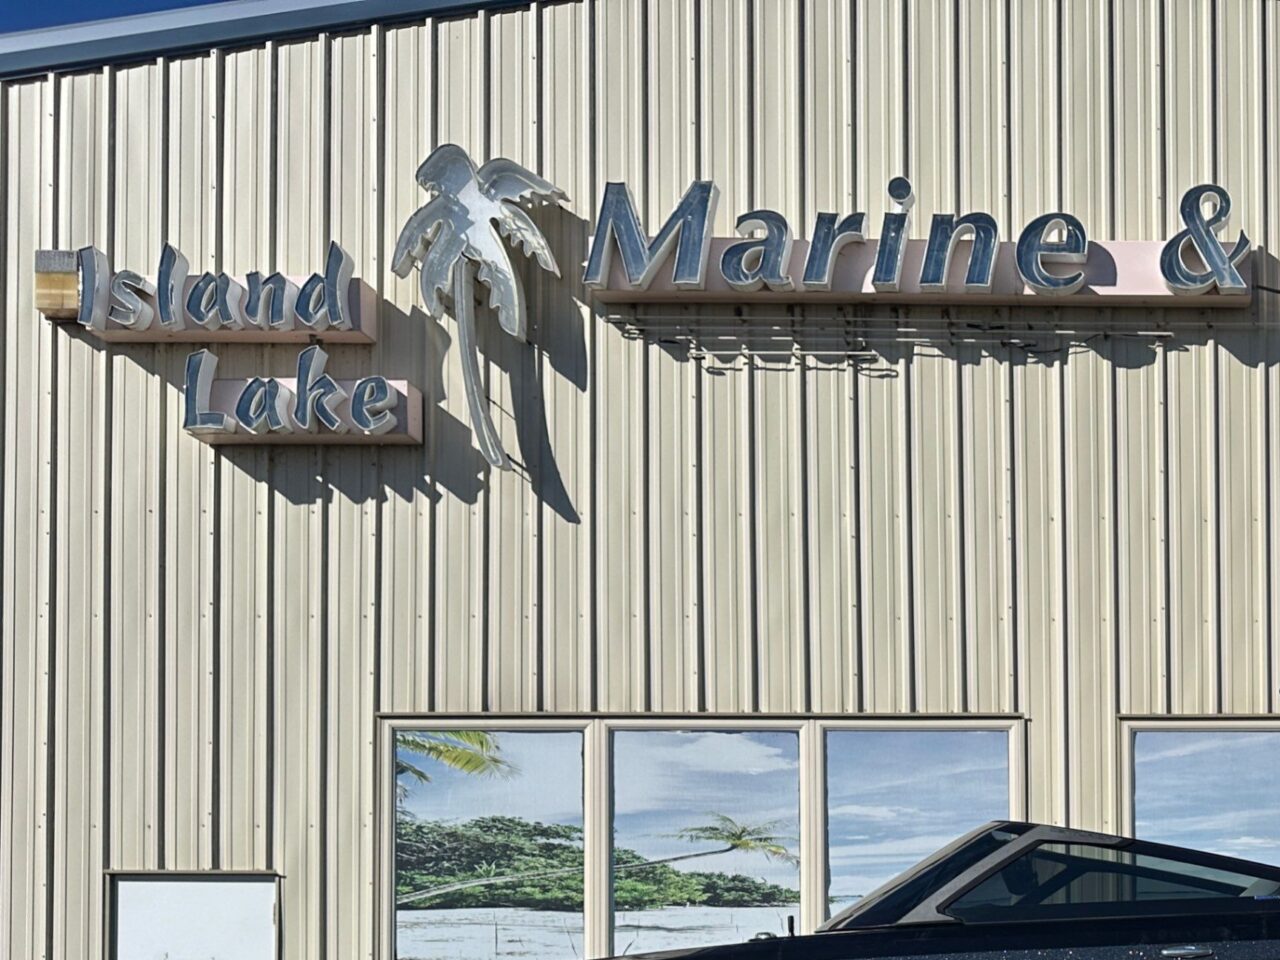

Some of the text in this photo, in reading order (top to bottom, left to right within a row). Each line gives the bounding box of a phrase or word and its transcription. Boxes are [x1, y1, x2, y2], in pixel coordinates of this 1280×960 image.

[581, 176, 1088, 295] Marine
[1158, 182, 1252, 295] &
[76, 240, 355, 330] Island
[183, 345, 399, 435] Lake
